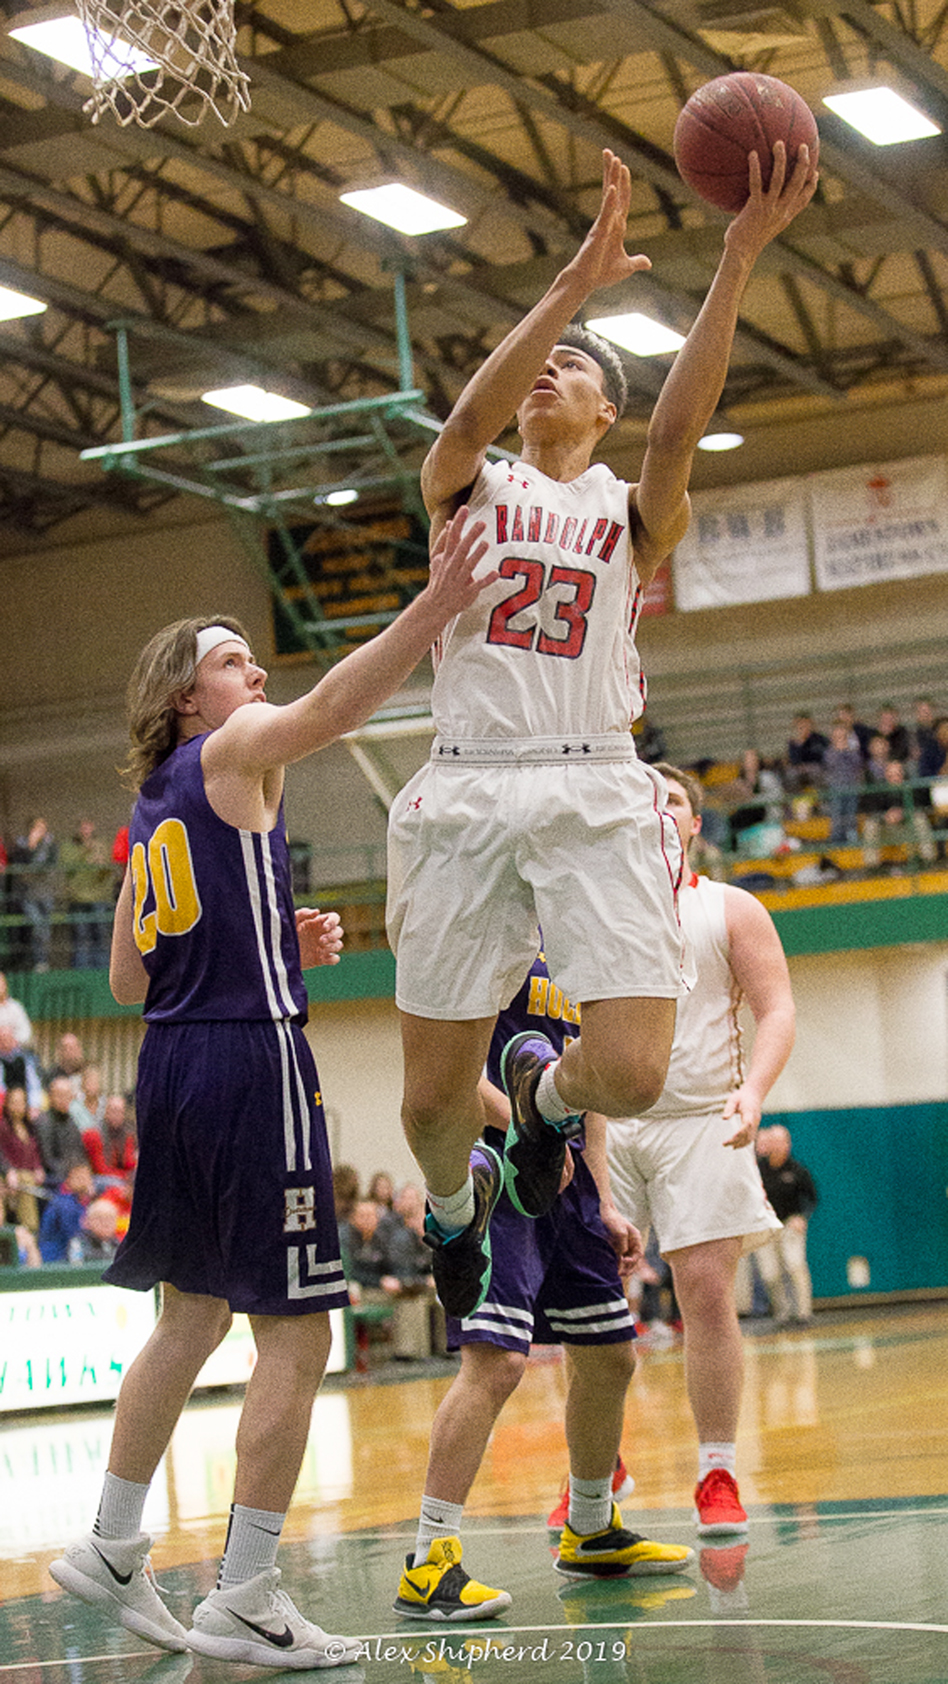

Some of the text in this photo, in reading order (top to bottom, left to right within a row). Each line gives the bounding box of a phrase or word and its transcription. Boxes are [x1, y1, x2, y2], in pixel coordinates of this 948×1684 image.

[495, 504, 625, 564] RANDOLPH
[486, 557, 596, 660] 23
[131, 817, 202, 956] 20
